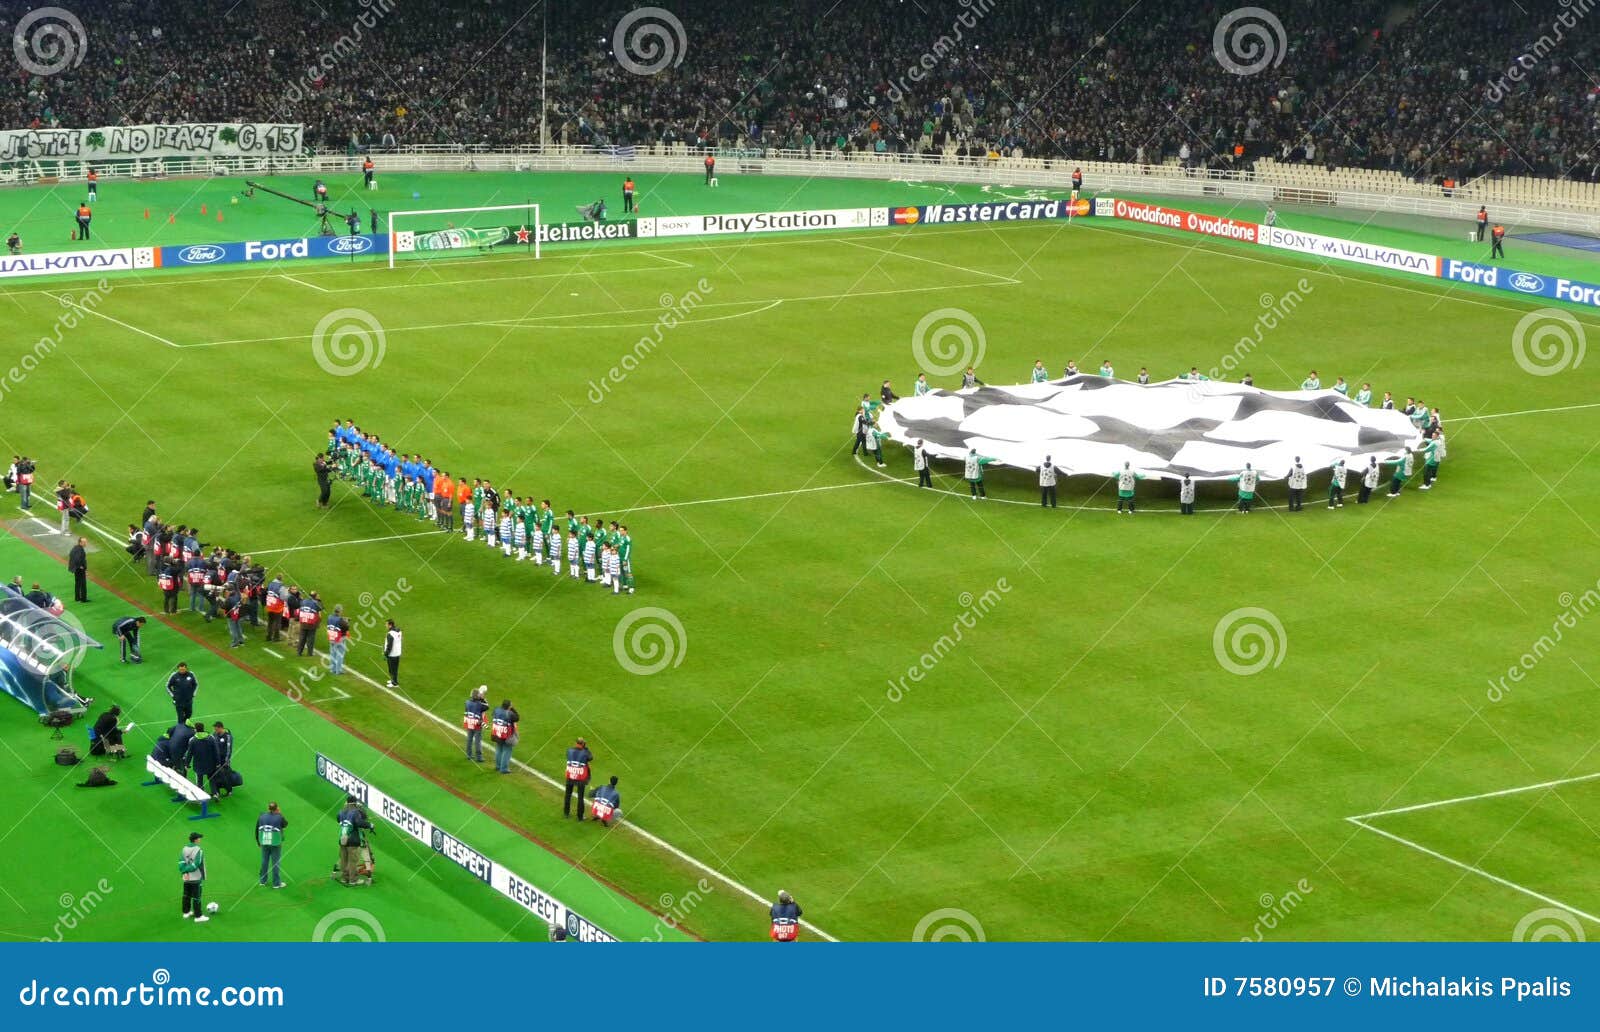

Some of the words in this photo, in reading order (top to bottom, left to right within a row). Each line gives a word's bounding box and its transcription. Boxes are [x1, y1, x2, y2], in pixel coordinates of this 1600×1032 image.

[110, 128, 149, 154] NO
[153, 125, 217, 151] PEACE
[662, 222, 691, 230] SONY
[703, 211, 837, 232] PlayStation
[924, 201, 1060, 223] MasterCard
[536, 222, 630, 243] Heineken
[1128, 207, 1181, 228] vodafone
[1199, 222, 1255, 241] vodafone
[187, 247, 216, 260] Ford
[245, 238, 309, 260] Ford
[1273, 231, 1317, 250] SONY
[1340, 243, 1430, 271] WALKMAN
[1449, 259, 1497, 286] Ford
[326, 761, 367, 803] RESPECT
[383, 797, 426, 839] RESPECT
[443, 834, 491, 881] RESPECT
[508, 876, 559, 924] RESPECT
[774, 925, 795, 933] PHOTO
